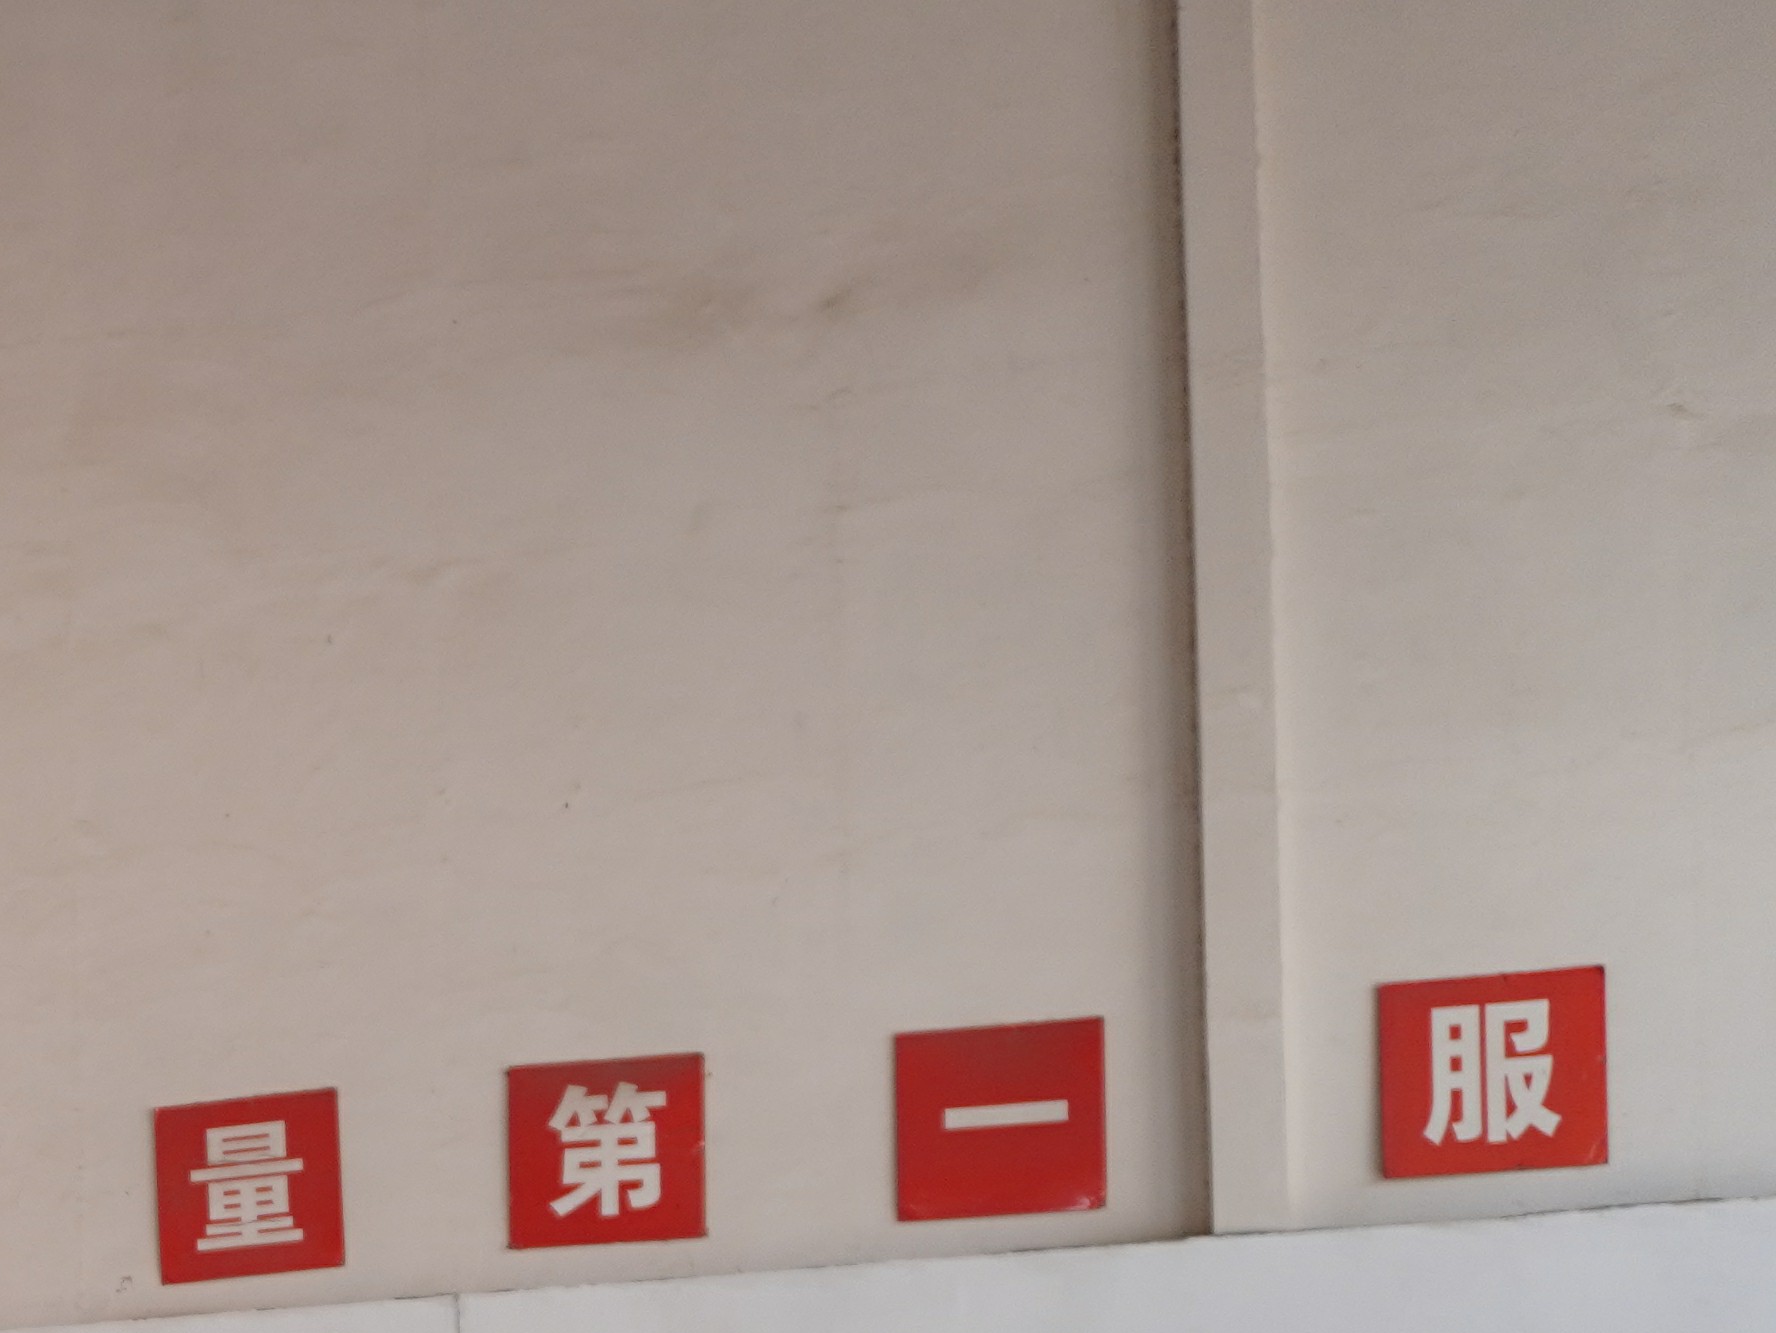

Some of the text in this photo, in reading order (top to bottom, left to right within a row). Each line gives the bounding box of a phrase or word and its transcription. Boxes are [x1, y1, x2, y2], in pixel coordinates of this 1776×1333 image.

[189, 1120, 304, 1252] 量
[548, 1080, 667, 1218] 第
[942, 1099, 1069, 1131] 一
[1423, 998, 1561, 1146] 服
